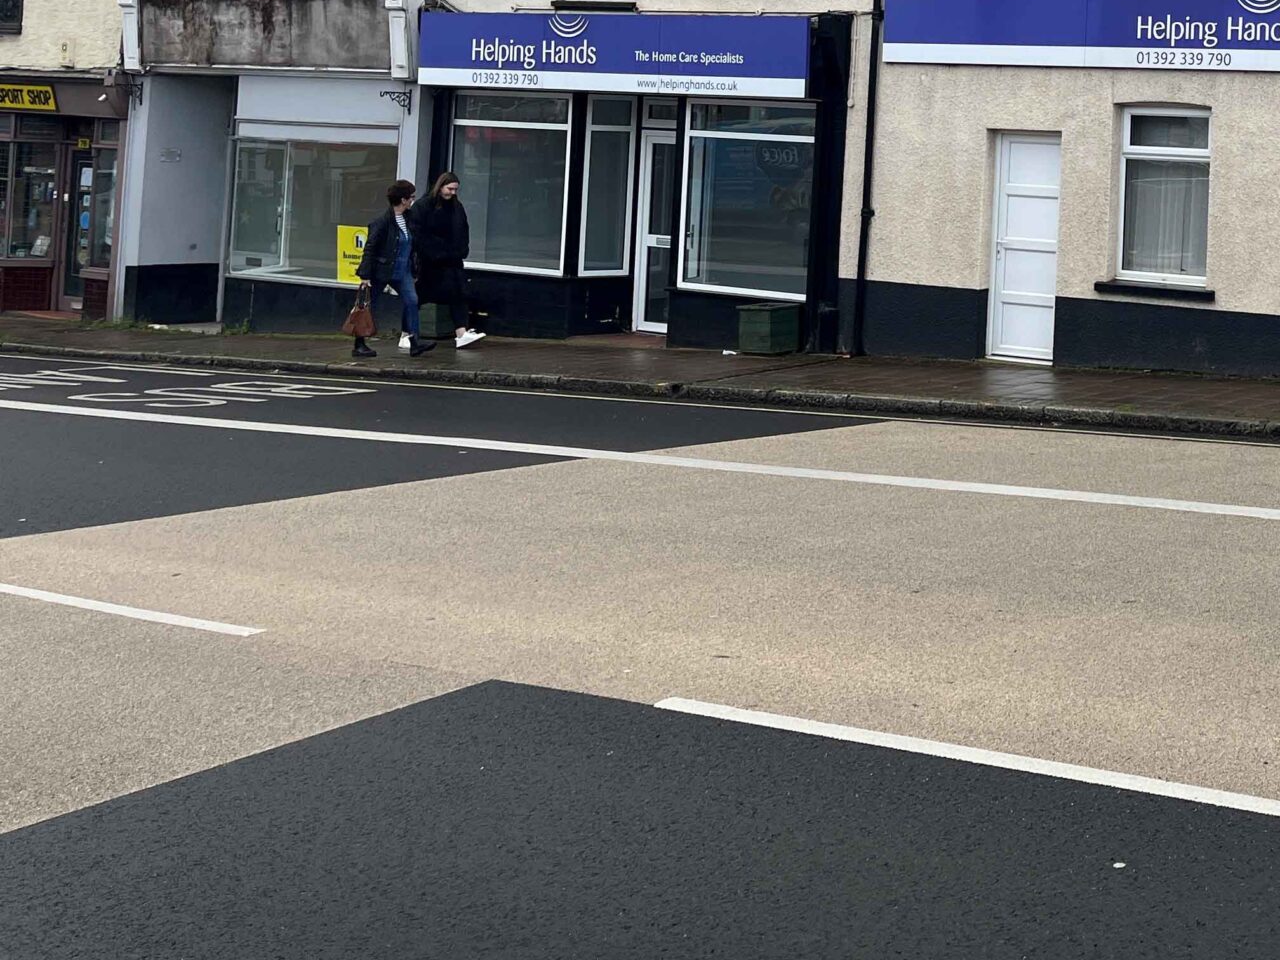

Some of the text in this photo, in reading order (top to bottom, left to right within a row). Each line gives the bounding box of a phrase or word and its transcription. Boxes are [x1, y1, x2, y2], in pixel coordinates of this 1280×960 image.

[1137, 14, 1218, 47] Helping
[472, 37, 597, 69] Helping Hands
[635, 50, 744, 66] The Home Care Specialists
[1136, 51, 1232, 66] 01392 339 790
[472, 72, 539, 85] 01392 339 790
[637, 78, 738, 92] www.helpinghands.co.uk
[27, 89, 52, 106] SHOP
